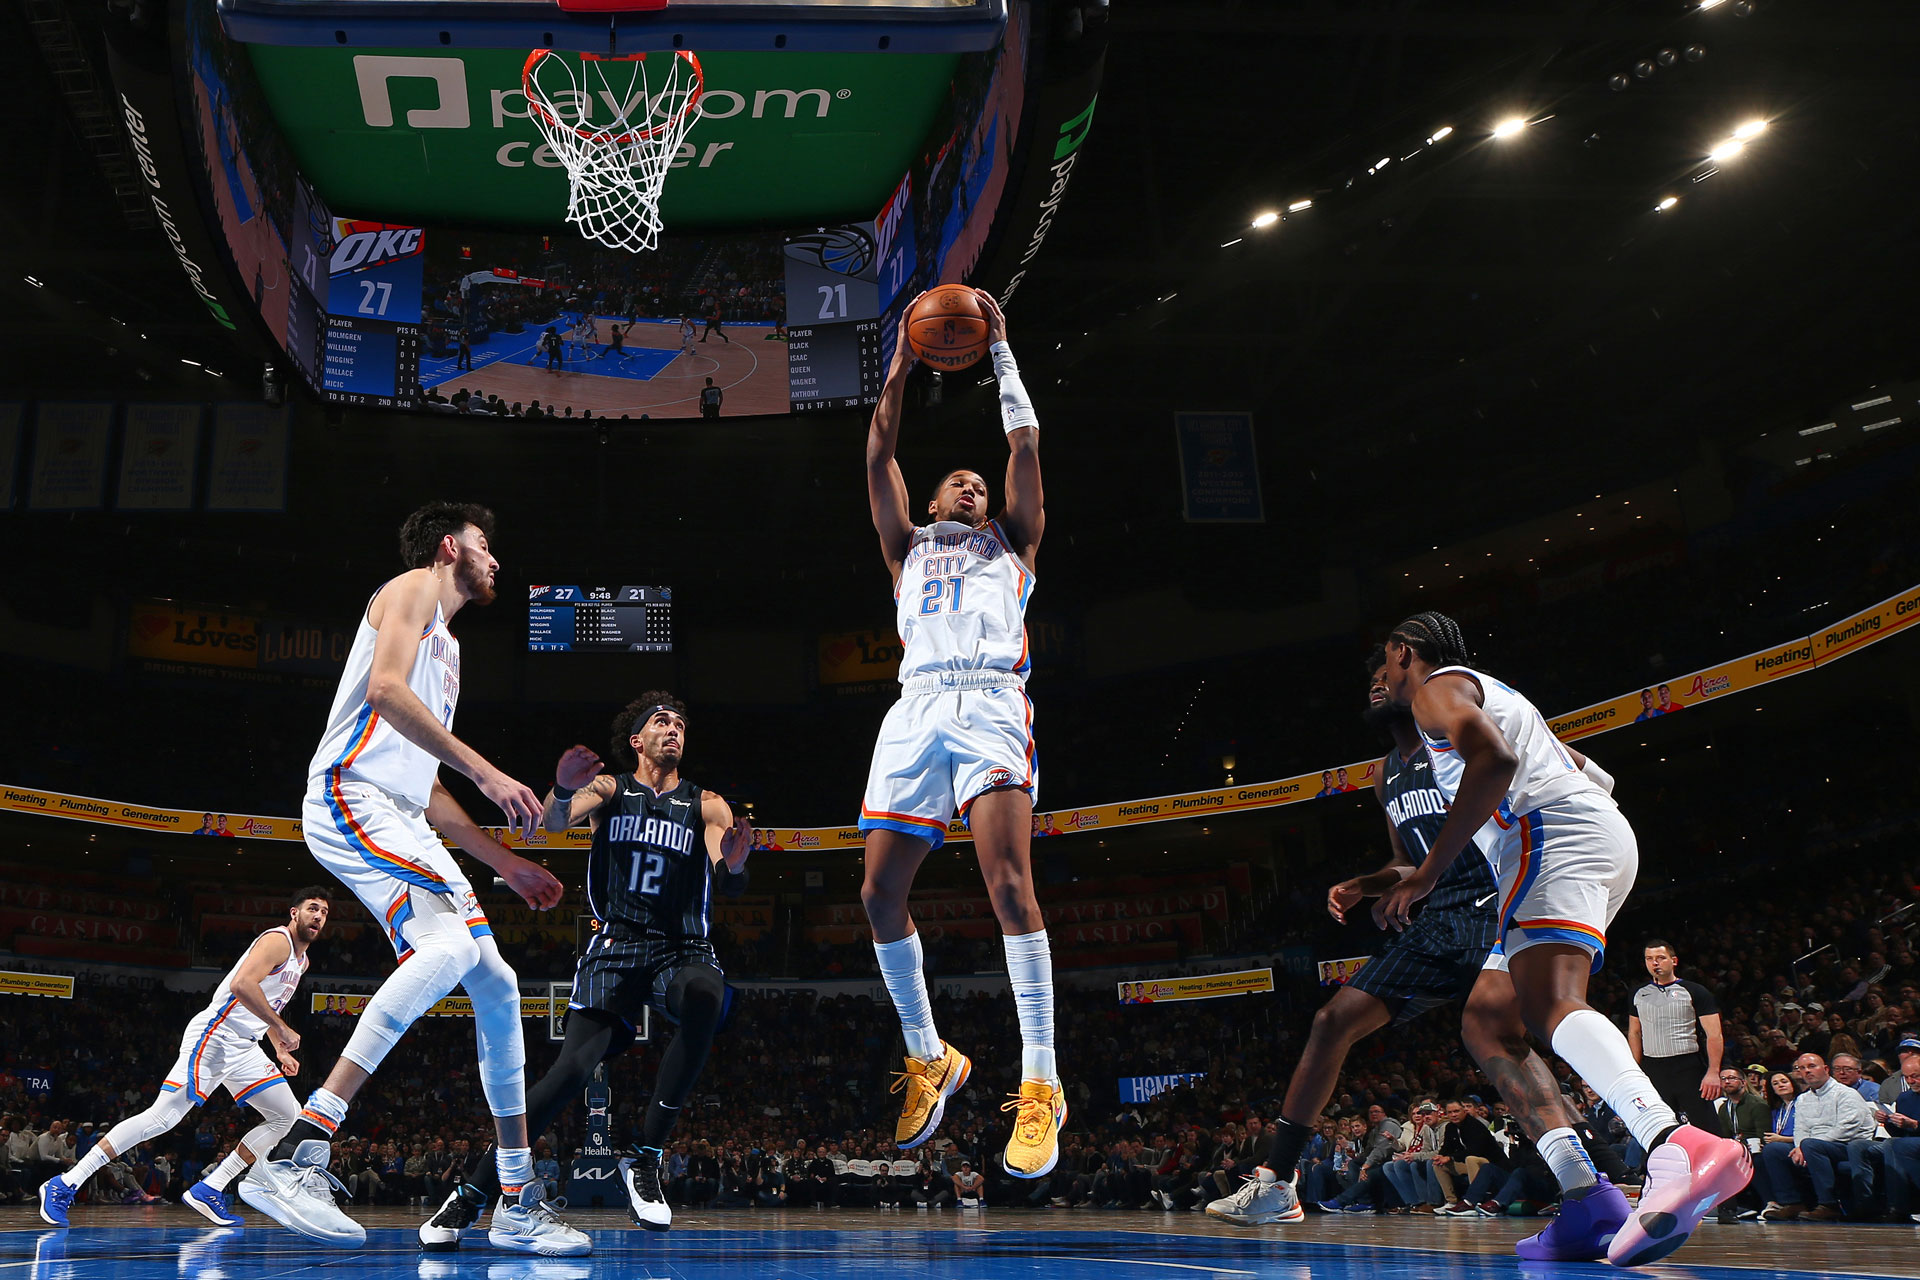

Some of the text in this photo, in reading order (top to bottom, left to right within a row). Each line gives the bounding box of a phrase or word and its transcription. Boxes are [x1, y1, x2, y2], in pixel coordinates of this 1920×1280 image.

[121, 92, 216, 300] paycom center
[330, 229, 422, 274] OKC
[890, 246, 904, 296] 27
[358, 280, 392, 316] 27
[818, 284, 848, 320] 21
[329, 319, 352, 328] PLAYER
[328, 331, 362, 341] HOLMGREN
[790, 330, 813, 338] PLAYER
[327, 342, 357, 352] WILLIAMS
[326, 355, 354, 365] WIGGINS
[922, 350, 978, 366] Wilson
[325, 367, 353, 377] WALLACE
[325, 379, 344, 388] MICIC
[791, 390, 819, 398] ANTHONY
[907, 532, 1000, 570] OKLAHOMA
[923, 554, 968, 578] CITY
[555, 588, 574, 600] 27
[629, 588, 645, 600] 21
[918, 576, 964, 616] 21
[1755, 614, 1881, 672] Heating Plumbing
[1683, 675, 1728, 698] Airco
[1552, 707, 1616, 734] Generators
[4, 790, 180, 823] Heating Plumbing Generators
[1118, 782, 1300, 817] Heating Plumbing Generators
[237, 818, 273, 836] Airco
[1064, 812, 1099, 828] Airco
[609, 815, 694, 856] ORLANDO
[785, 831, 819, 848] Airco
[628, 851, 665, 895] 12
[0, 978, 69, 989] Plumbing Generators
[1206, 981, 1232, 989] Plumbing
[445, 1000, 472, 1009] Plum
[584, 1146, 611, 1156] Health
